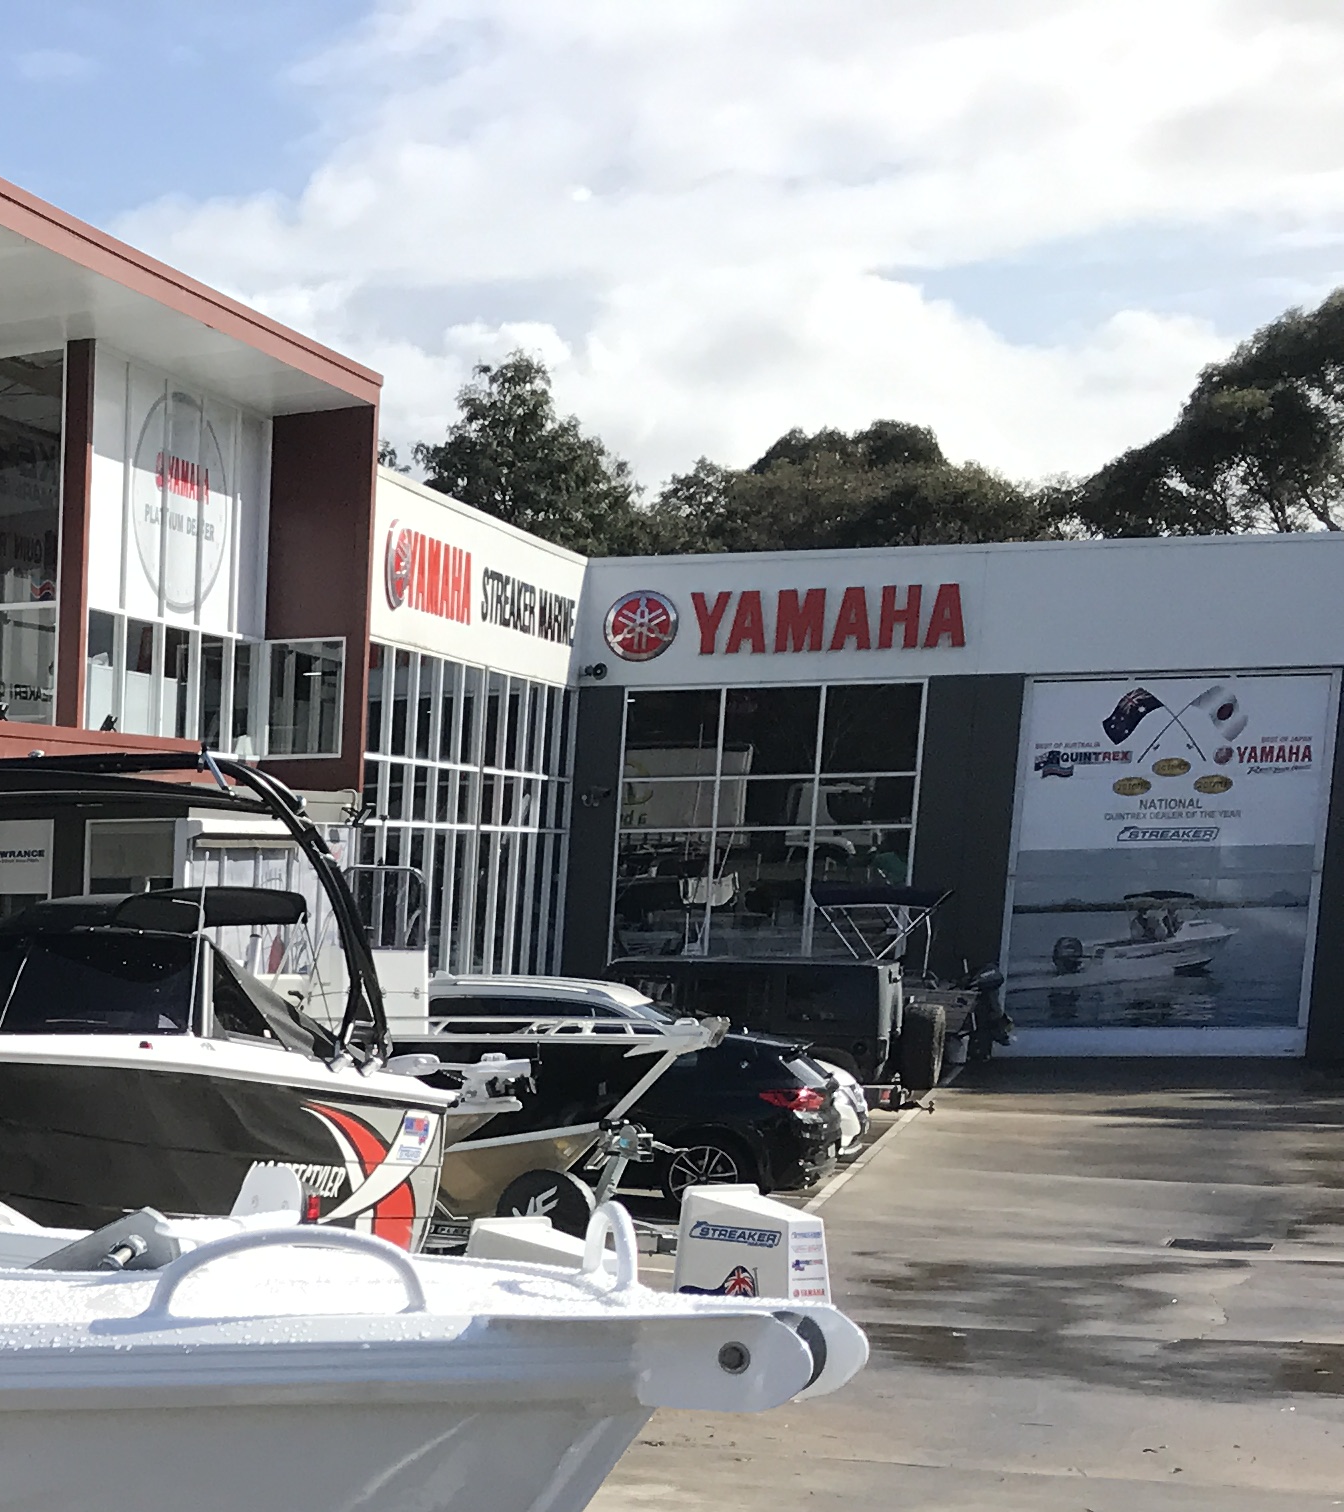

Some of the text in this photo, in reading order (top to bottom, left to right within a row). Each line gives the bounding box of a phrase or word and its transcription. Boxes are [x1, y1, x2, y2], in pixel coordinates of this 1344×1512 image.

[167, 454, 210, 506] YAMAA
[186, 516, 215, 543] DEER
[407, 529, 576, 648] YAMAHA STREAKER MARINE
[691, 583, 966, 656] YAMAHA
[1061, 751, 1130, 763] QUINTREX
[1236, 745, 1313, 764] YAMAHA
[1139, 798, 1203, 810] NATIONAL
[1127, 829, 1215, 839] STREAKER
[699, 1227, 778, 1244] STREAKER
